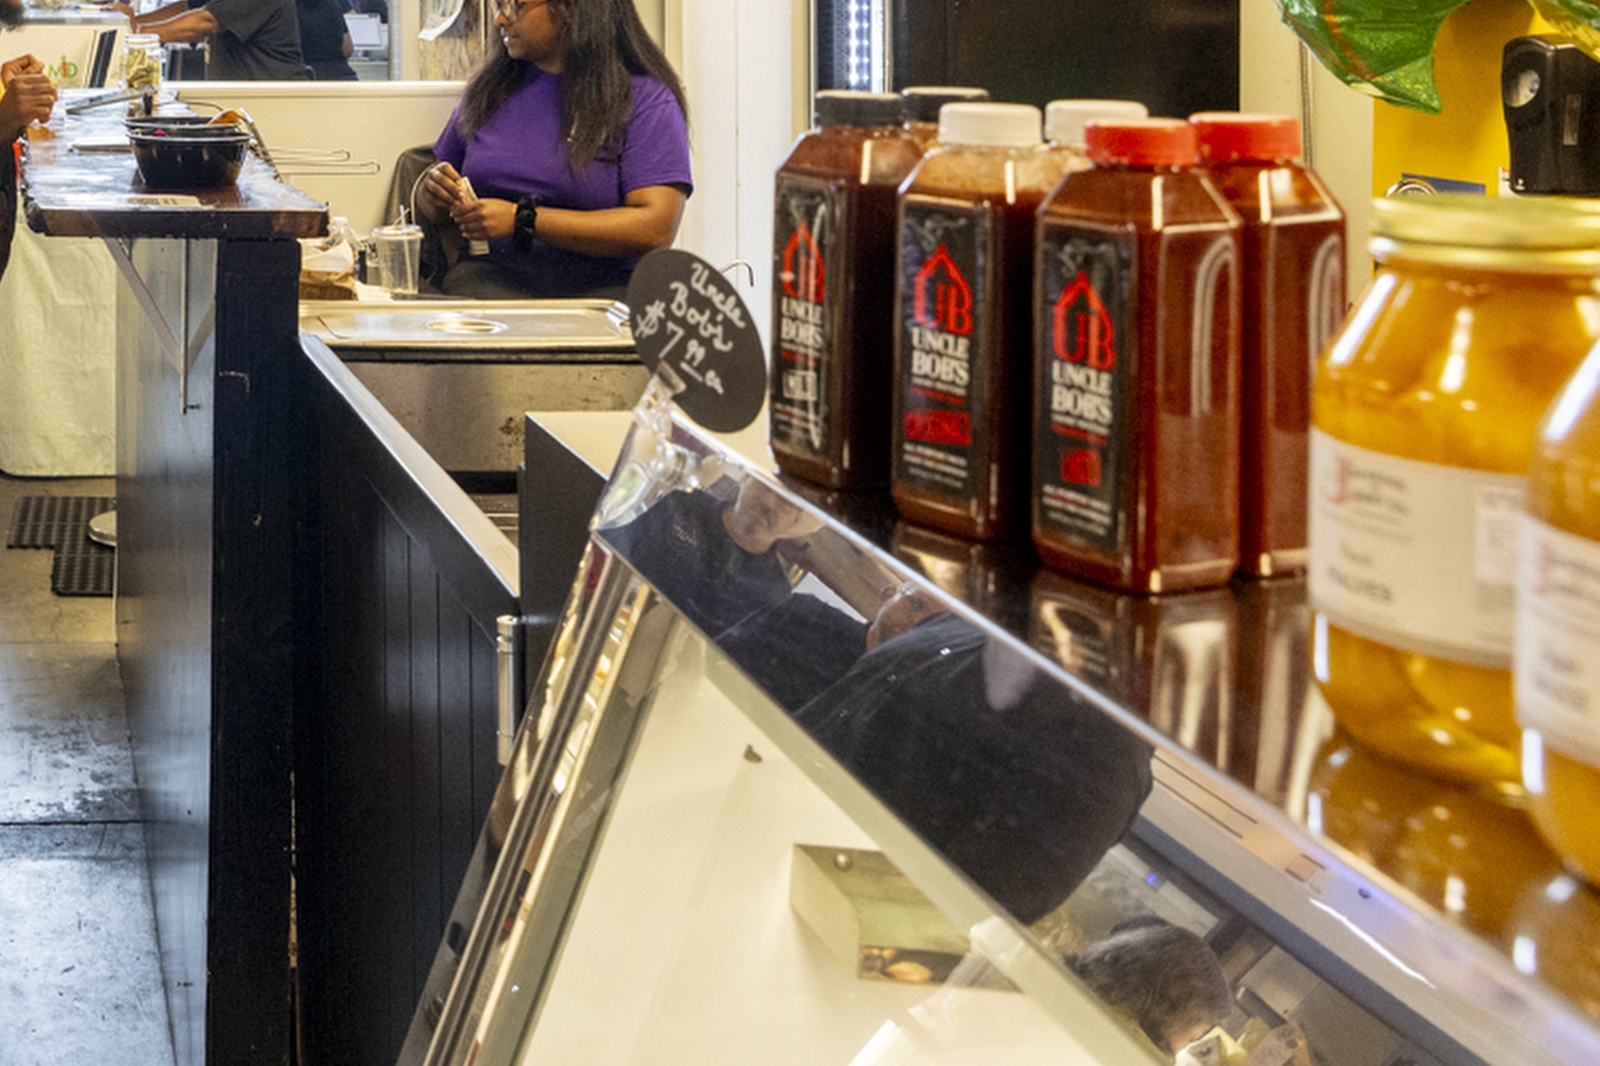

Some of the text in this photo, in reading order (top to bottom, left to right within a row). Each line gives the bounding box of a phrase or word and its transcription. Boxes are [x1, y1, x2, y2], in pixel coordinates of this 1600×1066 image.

[691, 262, 746, 328] Uncle
[912, 326, 970, 361] UNCLE
[1052, 359, 1113, 398] UNCLE
